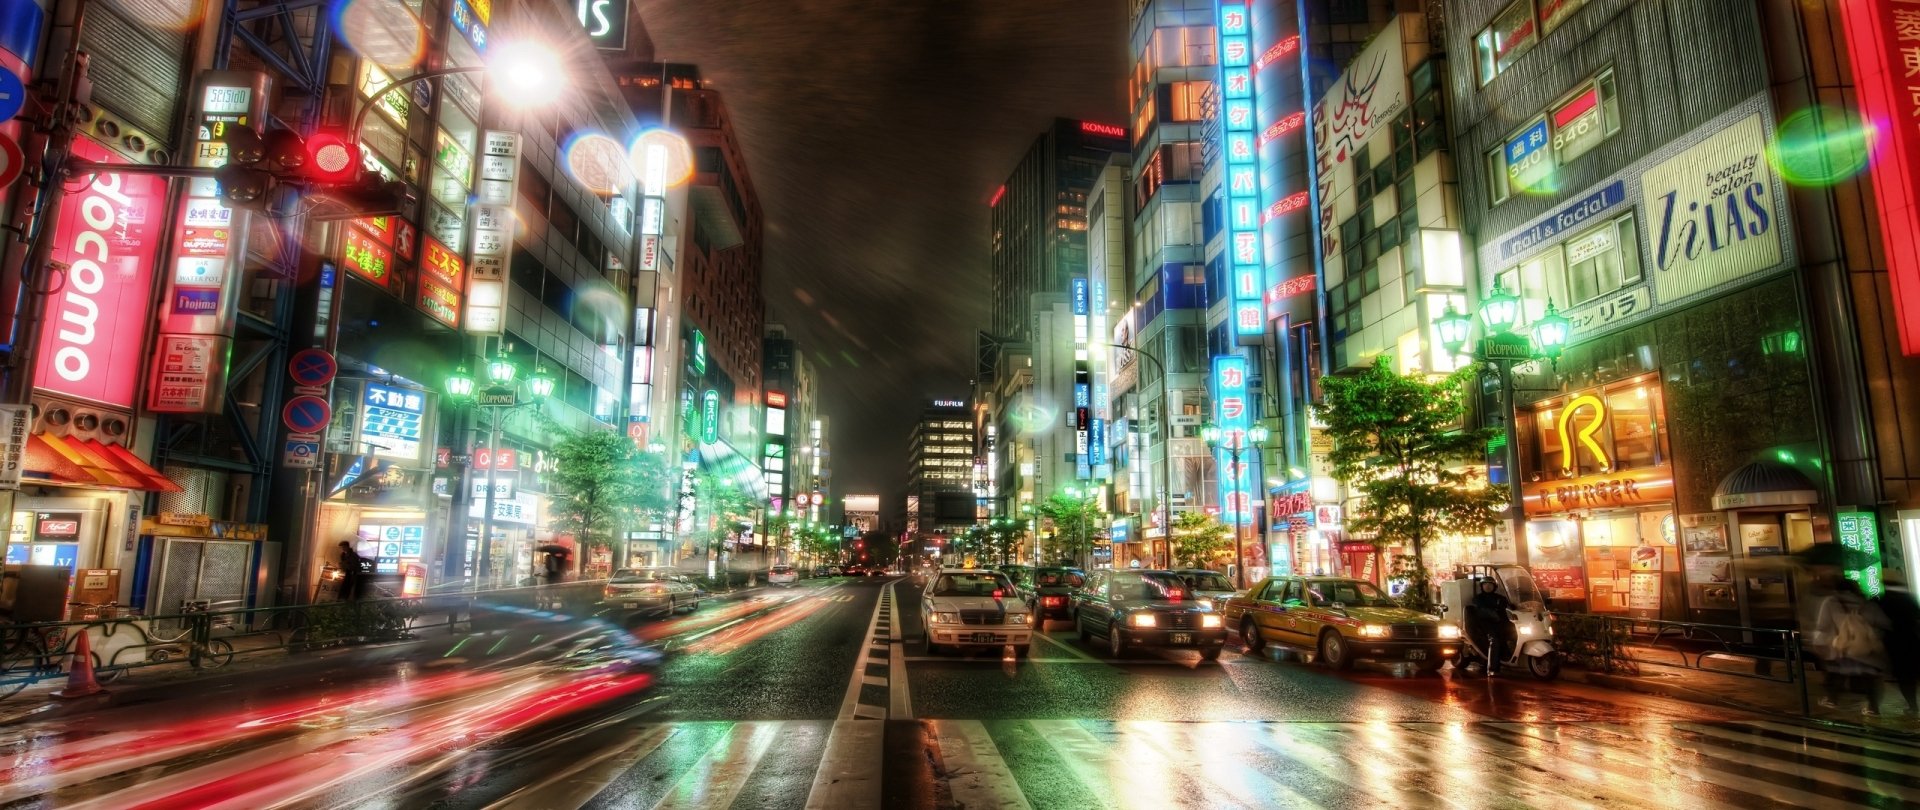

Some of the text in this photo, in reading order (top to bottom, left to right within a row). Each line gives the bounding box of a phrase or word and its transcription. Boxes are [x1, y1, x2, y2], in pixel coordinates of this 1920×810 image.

[1082, 121, 1124, 137] KONAMI
[1512, 128, 1544, 158] 歯科
[1706, 154, 1758, 187] beauty
[1711, 172, 1754, 200] salon
[1509, 232, 1541, 258] nail
[1557, 192, 1609, 231] facial
[428, 245, 461, 277] エステ
[1488, 341, 1530, 355] ROPPONGI
[369, 388, 421, 410] 不動産
[480, 392, 513, 405] ROPPONGI
[706, 401, 716, 440] モスバーガー
[1559, 395, 1609, 471] R
[476, 484, 507, 493] DRGS
[1841, 516, 1860, 550] 歯科
